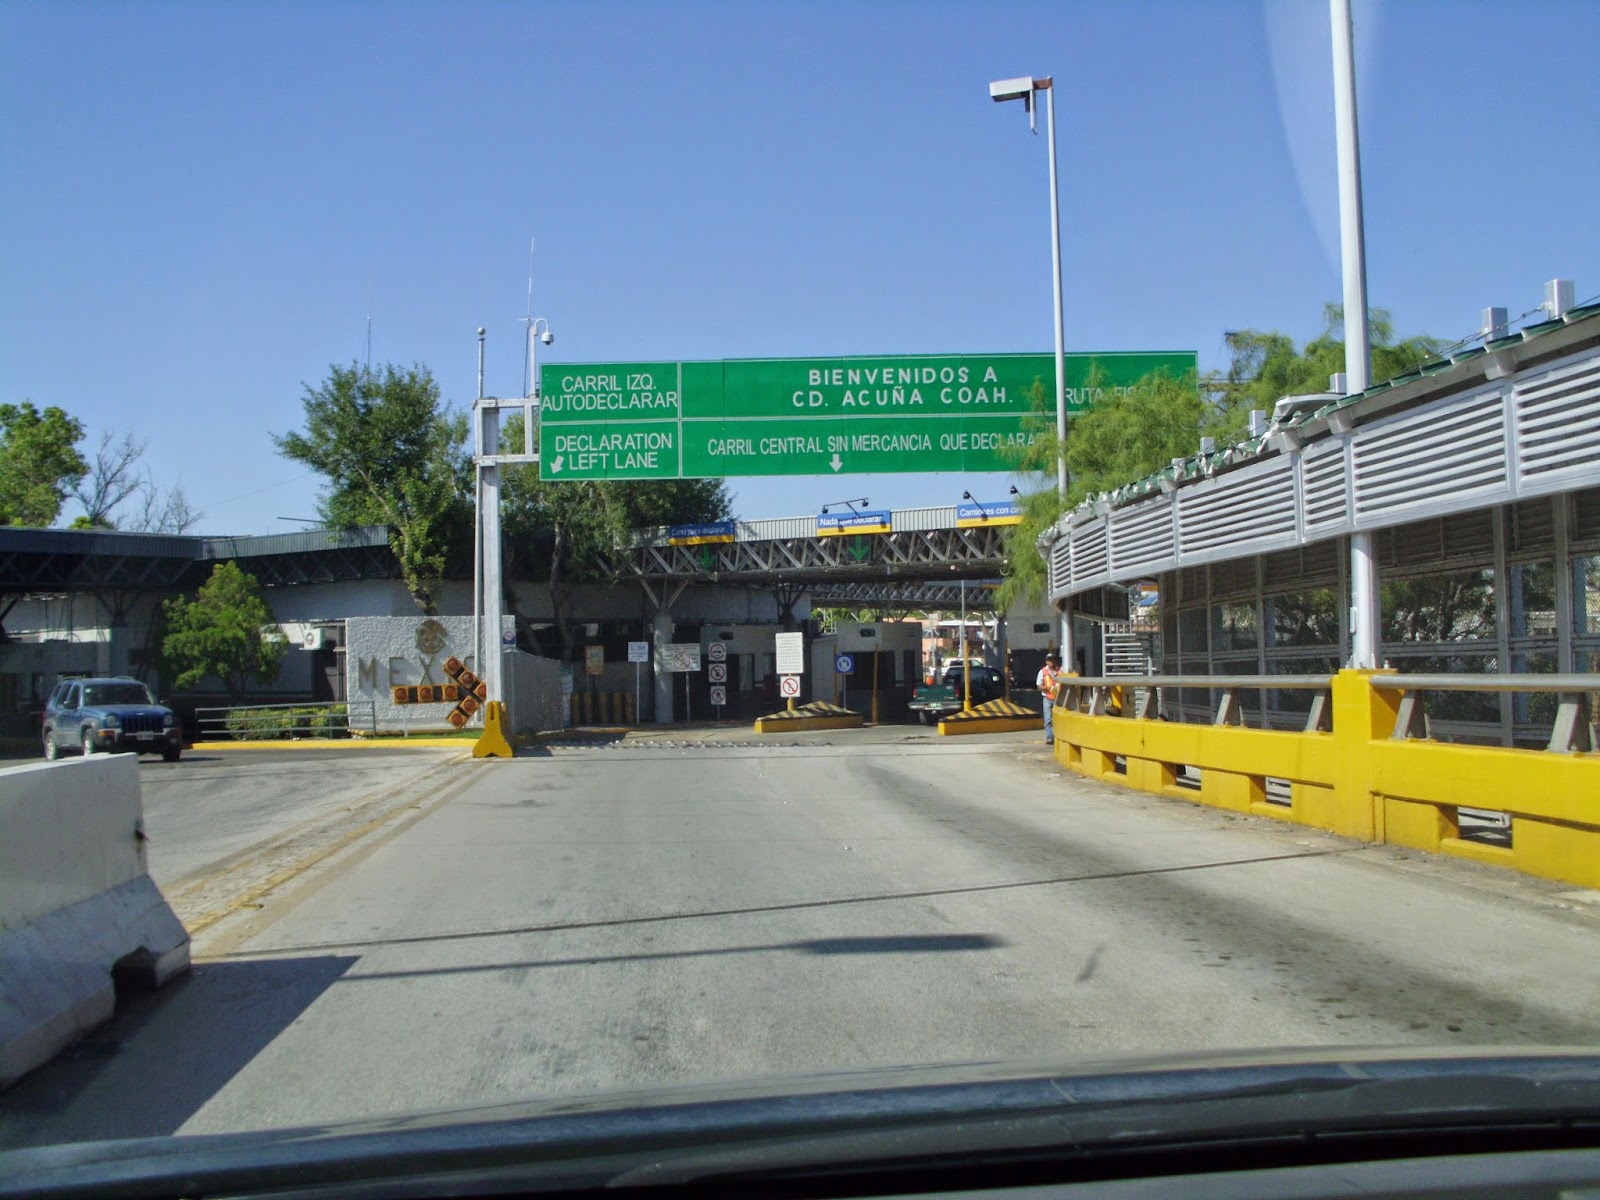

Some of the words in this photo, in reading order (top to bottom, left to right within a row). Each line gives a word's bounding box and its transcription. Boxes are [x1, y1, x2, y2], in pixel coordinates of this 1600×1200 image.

[562, 375, 621, 393] CARRIL
[627, 374, 657, 391] IZQ.
[809, 367, 969, 386] BIENVENIDOS
[983, 366, 998, 383] A
[541, 391, 678, 411] AUTODECLARAR
[792, 391, 829, 407] CD.
[841, 386, 923, 407] ACUÑA
[940, 387, 1013, 404] COAH.
[1065, 387, 1103, 405] RUTA
[555, 433, 672, 452] DECLARATION
[708, 438, 755, 456] CARRIL
[760, 436, 823, 454] CENTRAL
[827, 435, 848, 452] SIN
[851, 434, 932, 452] MERCANCIA
[940, 433, 968, 451] QUE
[569, 453, 610, 471] LEFT
[615, 451, 658, 469] LANE
[960, 508, 994, 517] Camioes
[996, 507, 1009, 515] con
[820, 518, 838, 526] Nada
